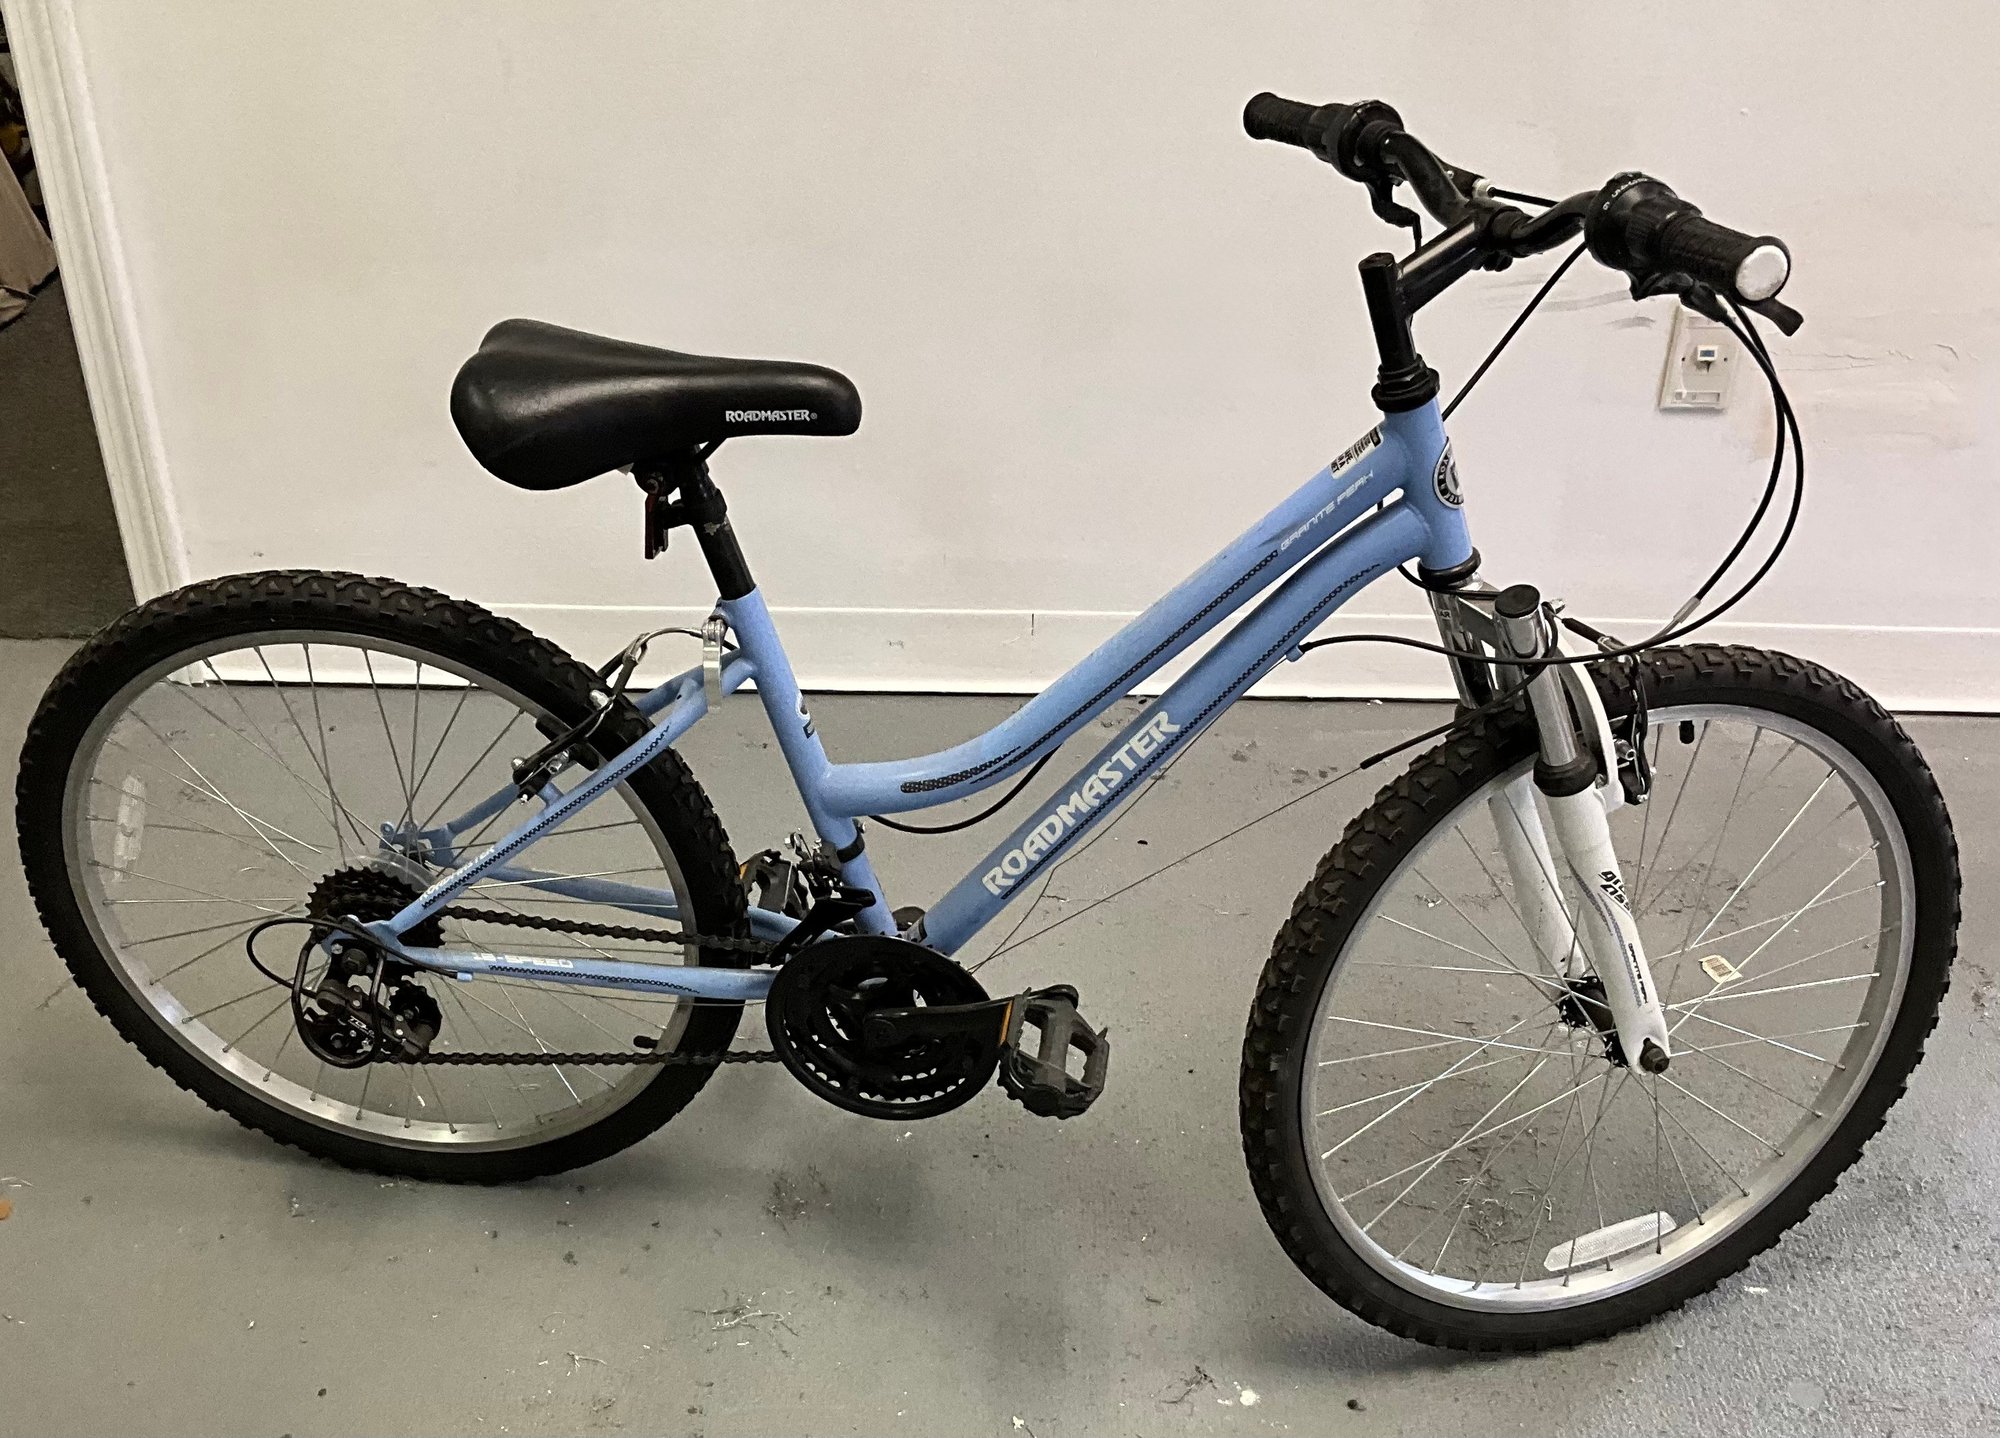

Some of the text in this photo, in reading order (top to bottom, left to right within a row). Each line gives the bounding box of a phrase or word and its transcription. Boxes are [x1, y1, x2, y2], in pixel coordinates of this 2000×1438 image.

[725, 409, 811, 423] ROADMASTER
[1280, 502, 1336, 551] GRANITE
[982, 711, 1181, 896] ROADMASTER
